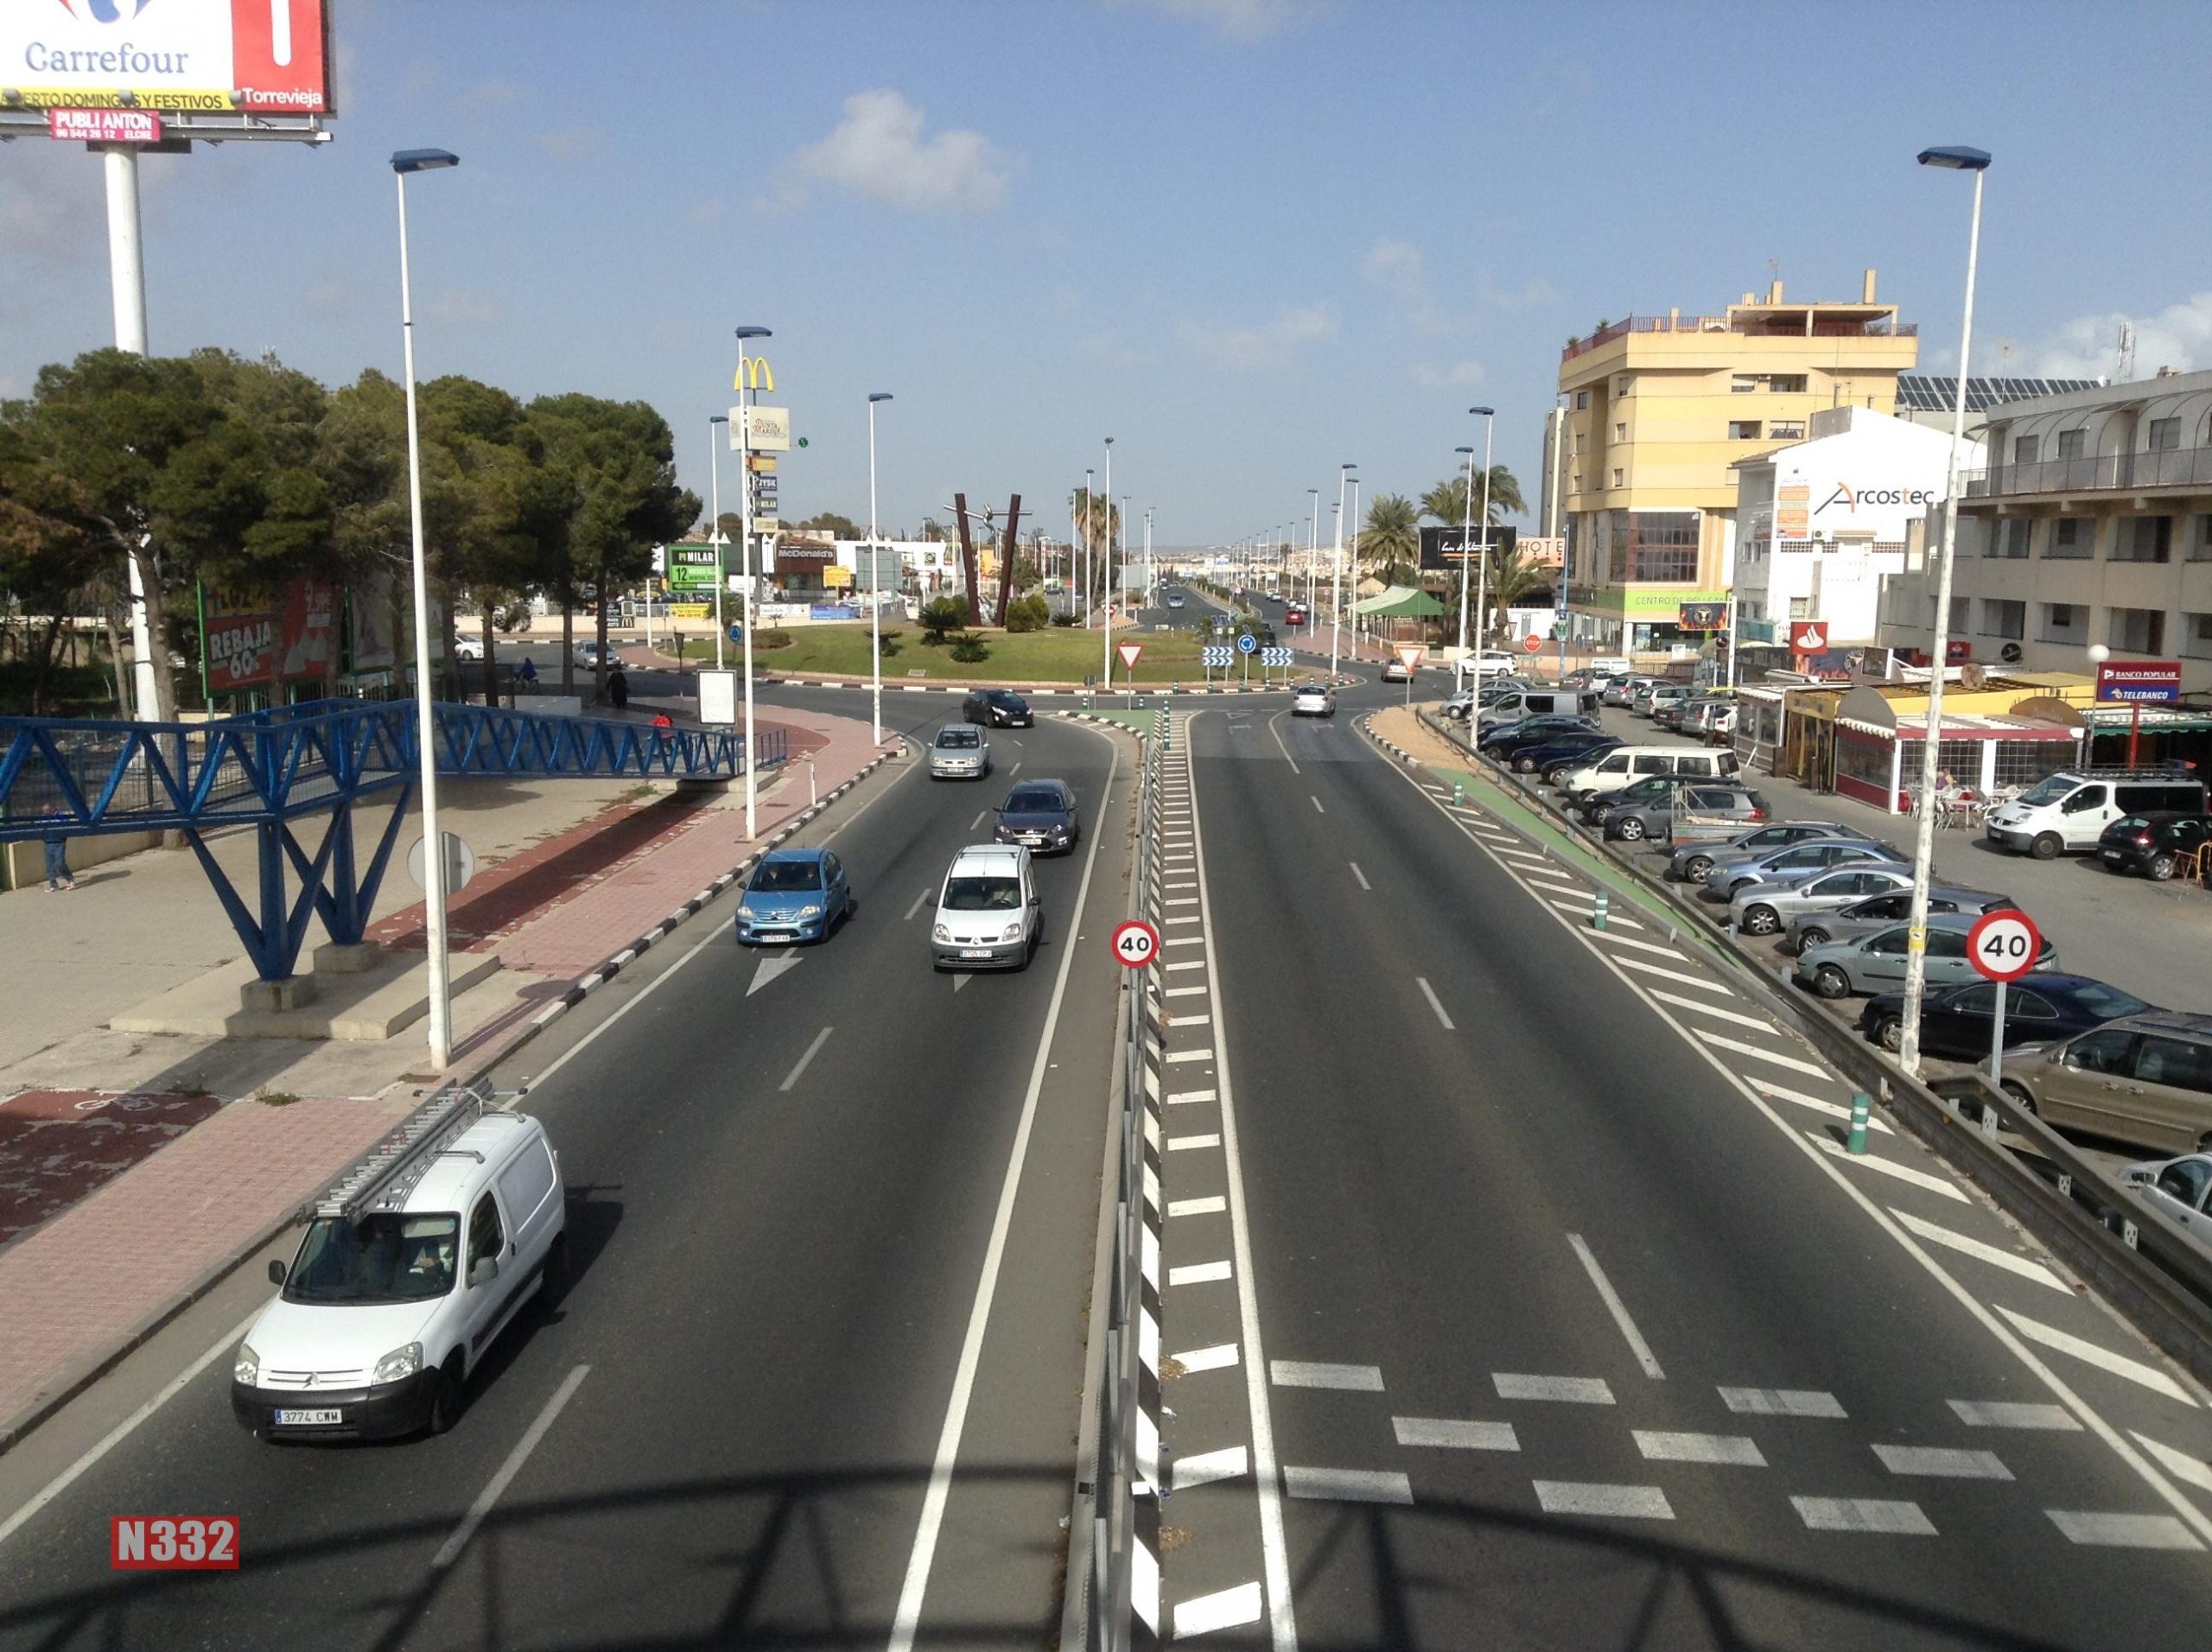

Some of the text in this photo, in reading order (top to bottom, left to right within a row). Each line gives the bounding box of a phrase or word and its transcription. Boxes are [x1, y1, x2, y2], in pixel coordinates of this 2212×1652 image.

[25, 41, 188, 74] Carrefour
[0, 91, 222, 109] AERTO DOMINGS Y FESTIVOS
[242, 87, 322, 108] Torrevieja
[55, 111, 100, 129] PUBLI
[759, 479, 777, 487] JYSK
[1814, 481, 1935, 517] Arcostec
[687, 551, 715, 562] MILAR
[779, 550, 834, 558] McDonald's
[676, 567, 688, 581] 12
[1636, 596, 1671, 605] CENTRO
[209, 620, 271, 661] REBAJA
[2123, 690, 2169, 700] TELEBANCO
[1120, 937, 1150, 952] 40
[1983, 934, 2027, 958] 40
[283, 1411, 312, 1423] 3774
